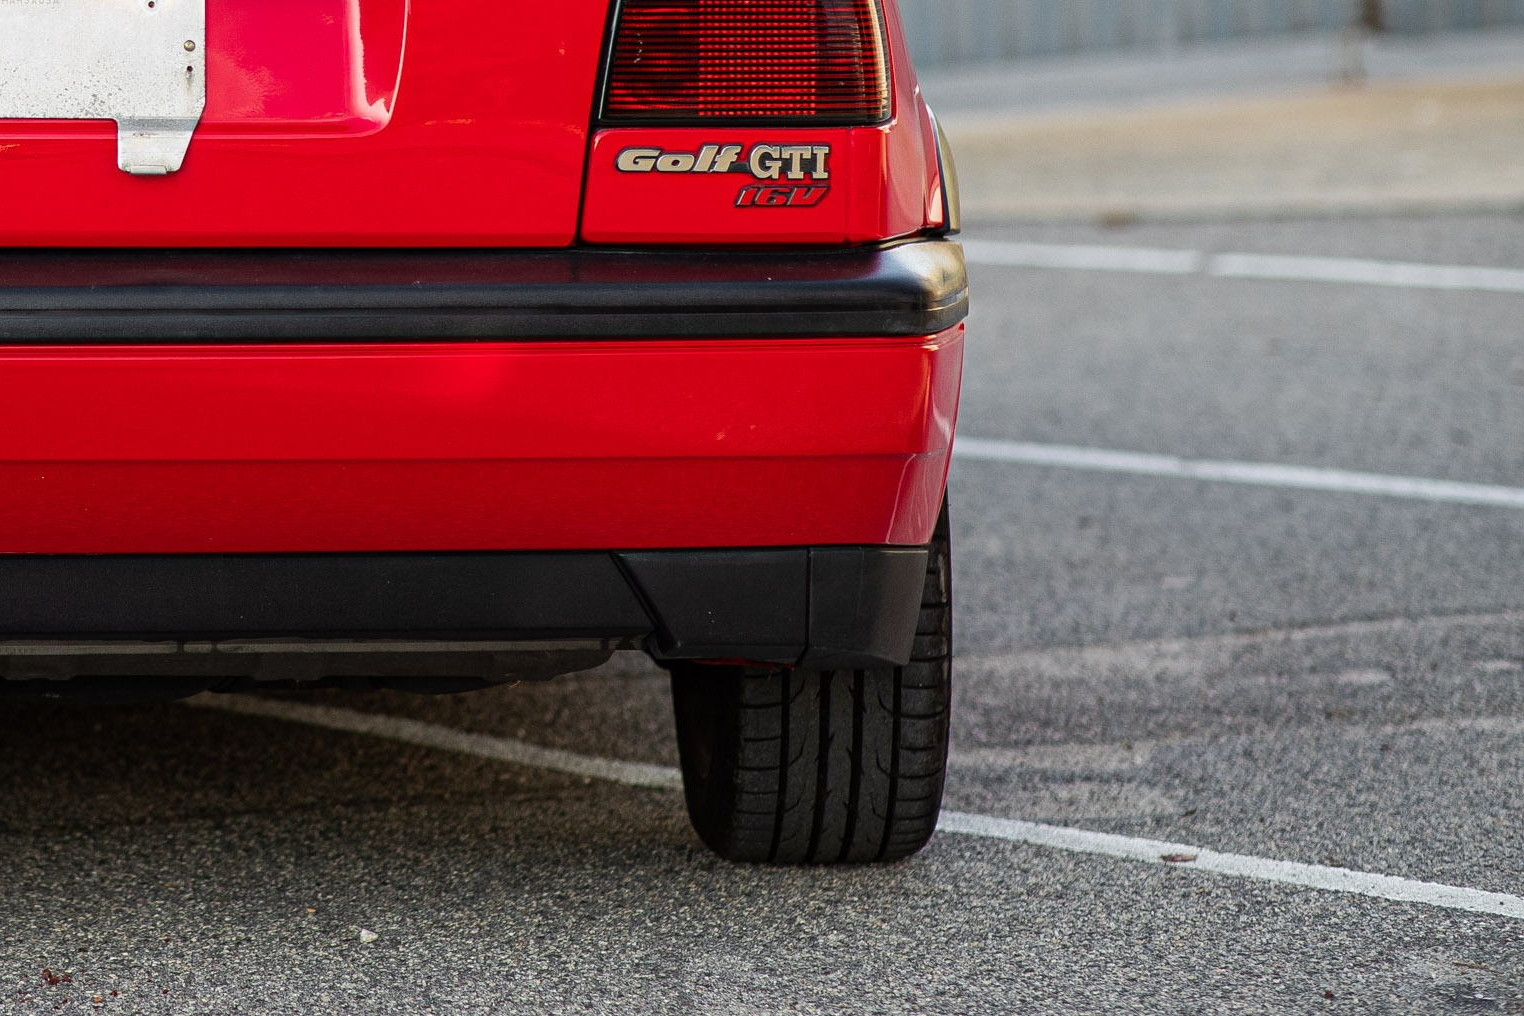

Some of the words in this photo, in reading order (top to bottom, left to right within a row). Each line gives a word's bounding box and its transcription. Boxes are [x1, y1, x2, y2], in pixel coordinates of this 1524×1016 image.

[616, 144, 743, 173] Golf
[749, 143, 830, 180] GTI
[734, 185, 830, 207] 16V
